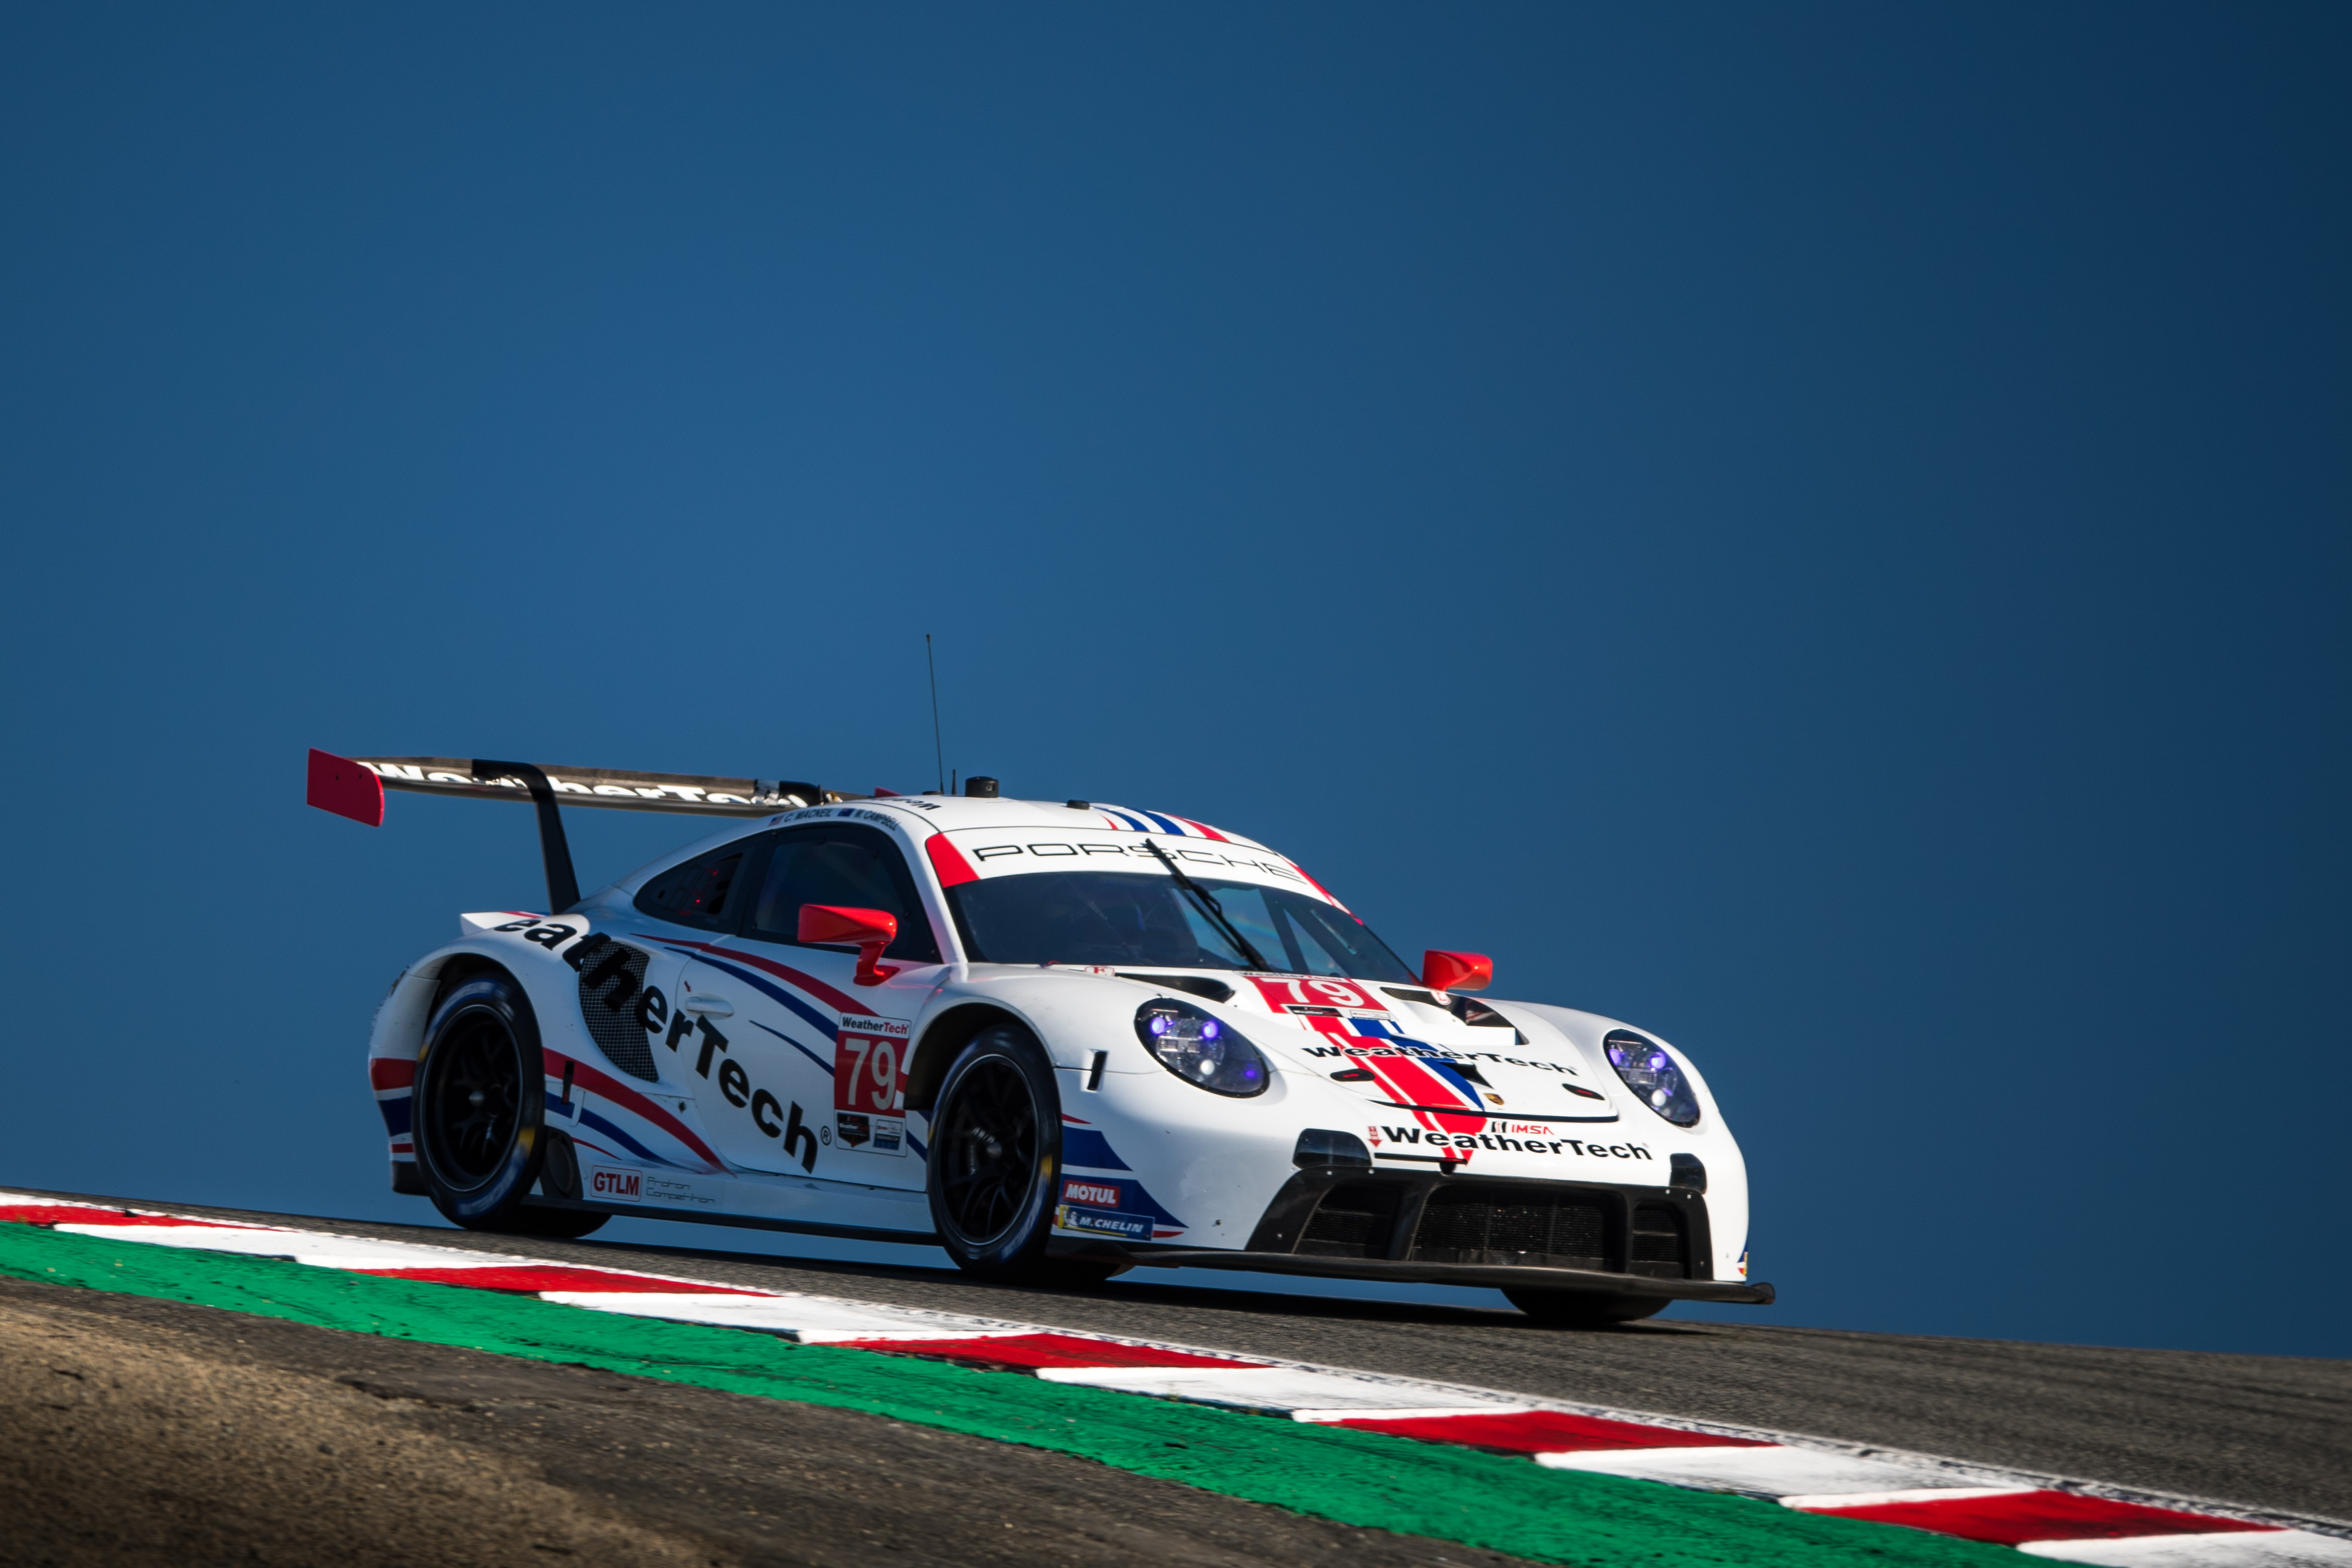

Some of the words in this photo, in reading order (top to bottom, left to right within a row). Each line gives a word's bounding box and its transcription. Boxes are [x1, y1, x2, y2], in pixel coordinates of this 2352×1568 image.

[794, 808, 832, 821] MACNEIL
[863, 810, 902, 831] CAMPBELL
[972, 843, 1307, 885] PORSCHE
[1259, 977, 1365, 1007] 79
[842, 1017, 909, 1034] WeatherTech
[1301, 1046, 1578, 1076] WeatherTech
[845, 1037, 896, 1110] 79
[1511, 1124, 1555, 1135] IMSA
[1380, 1126, 1653, 1160] WeatherTech
[593, 1171, 640, 1196] GTLM
[647, 1176, 691, 1190] Proton
[1066, 1184, 1117, 1204] MOTUL
[1079, 1217, 1144, 1233] MCHELIN
